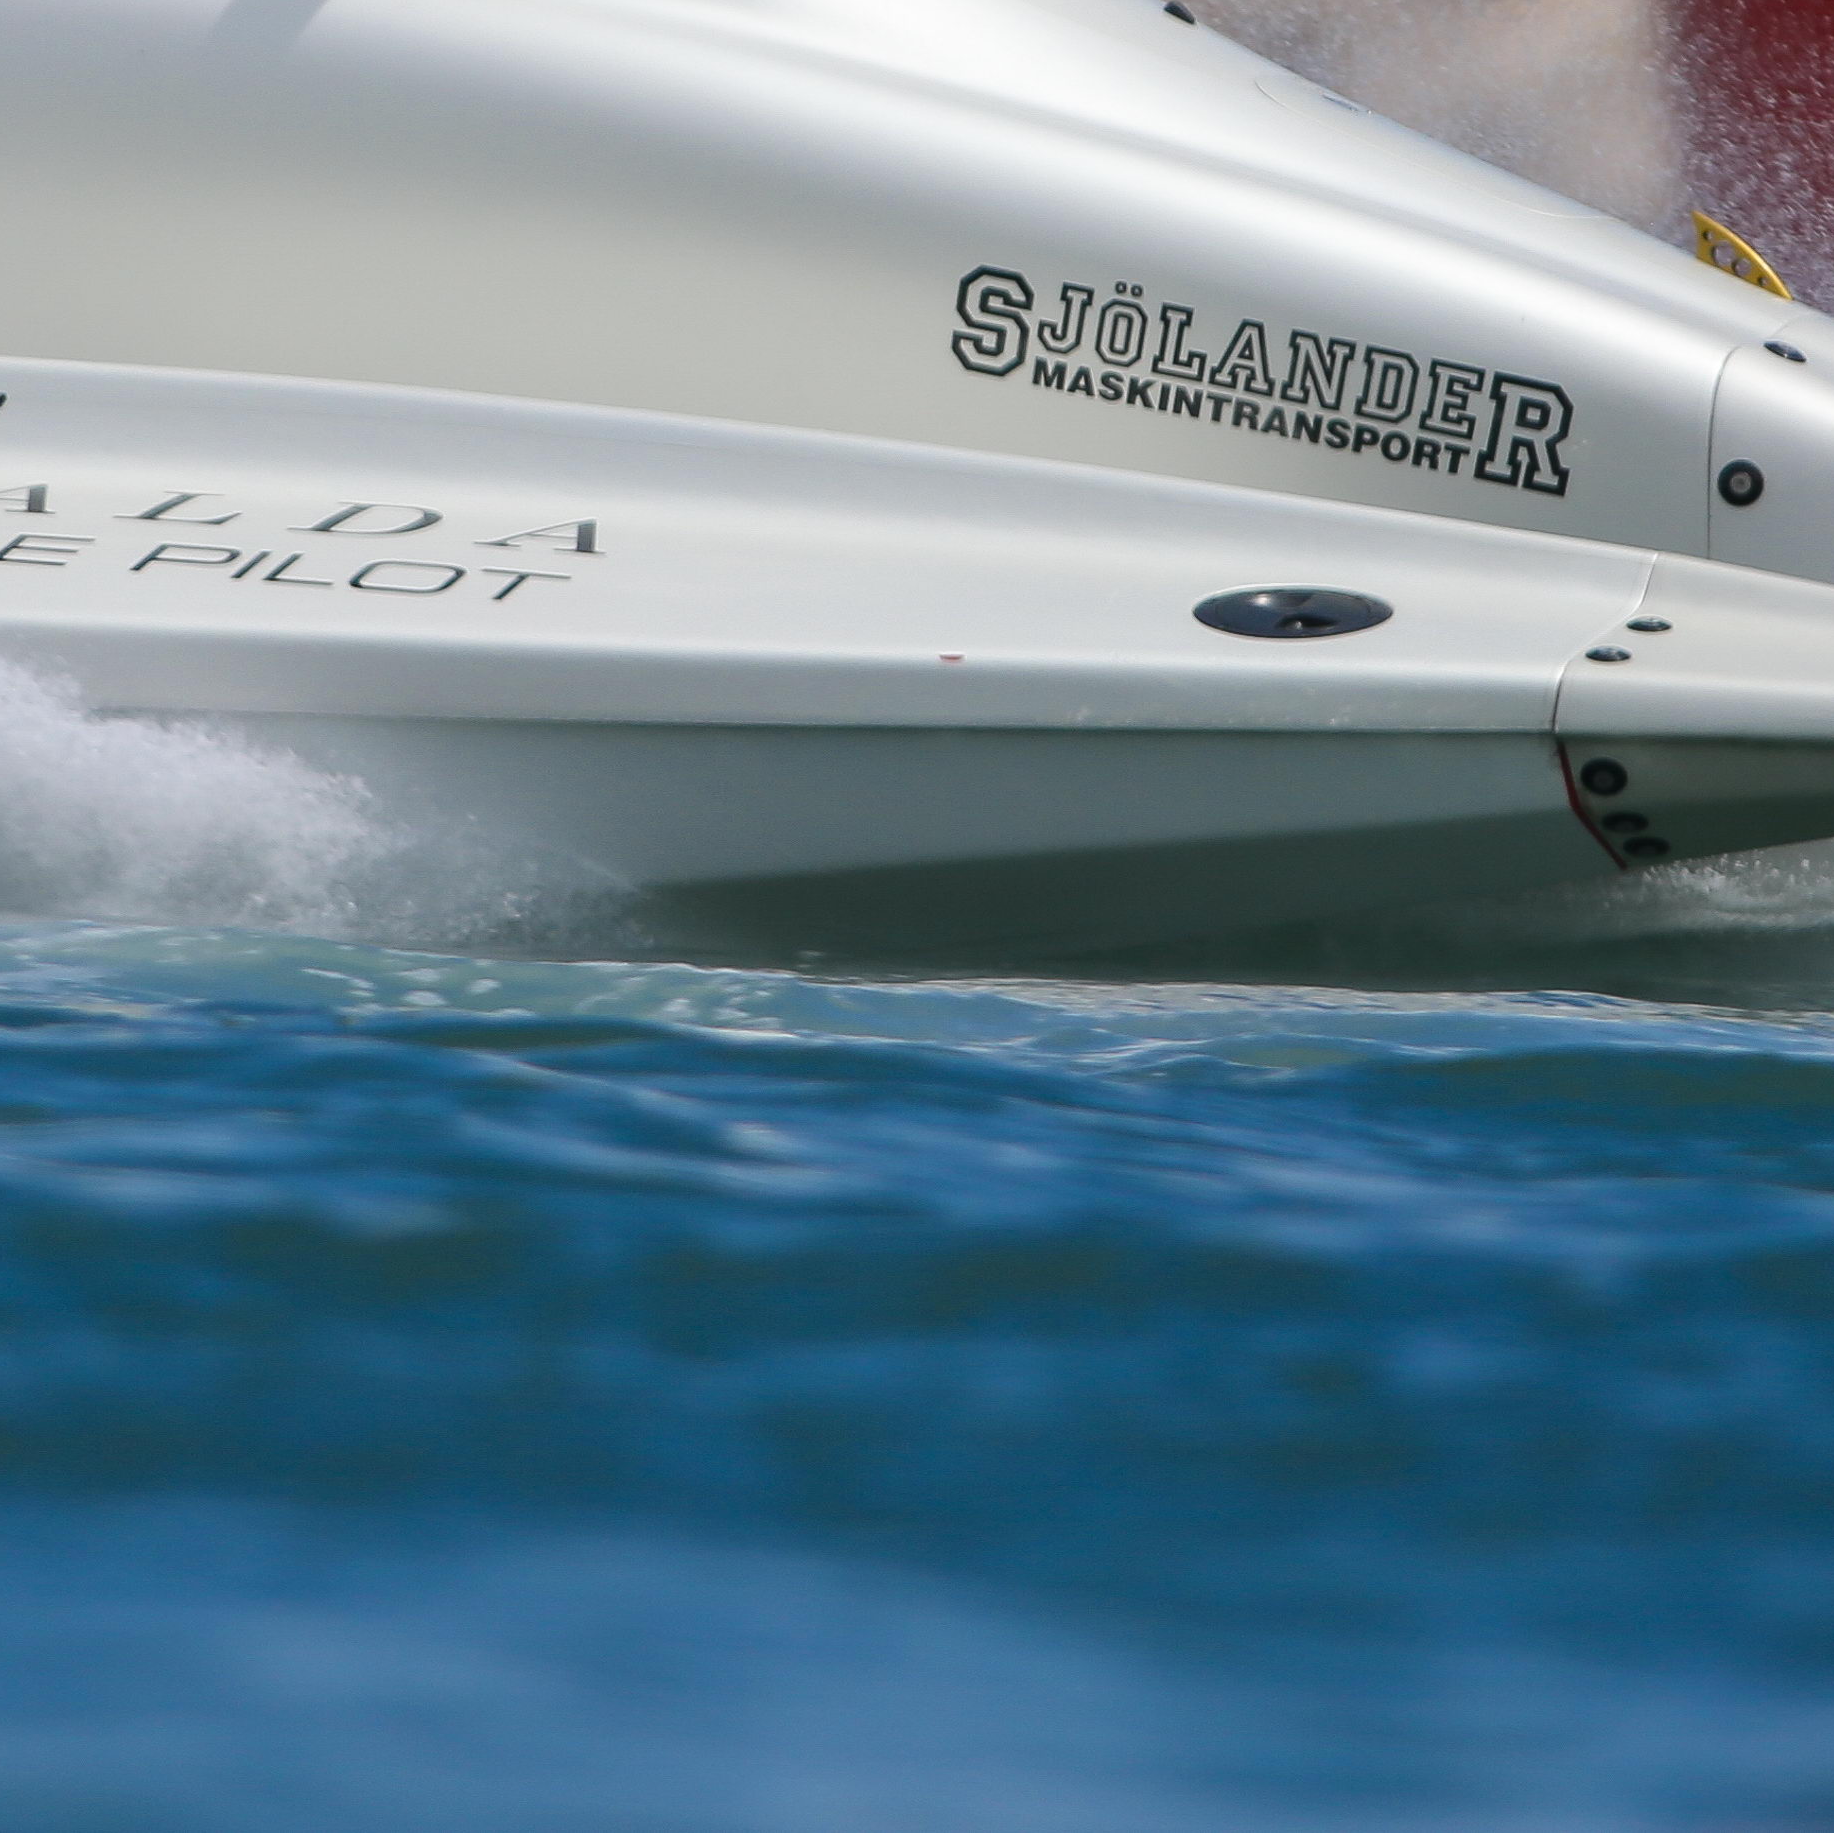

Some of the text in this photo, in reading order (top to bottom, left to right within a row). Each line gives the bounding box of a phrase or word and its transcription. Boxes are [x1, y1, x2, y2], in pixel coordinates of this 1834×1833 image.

[951, 263, 1575, 497] SJÖLANDER
[1031, 355, 1473, 475] MASKINTRANSPORT
[128, 540, 575, 601] PILOT
